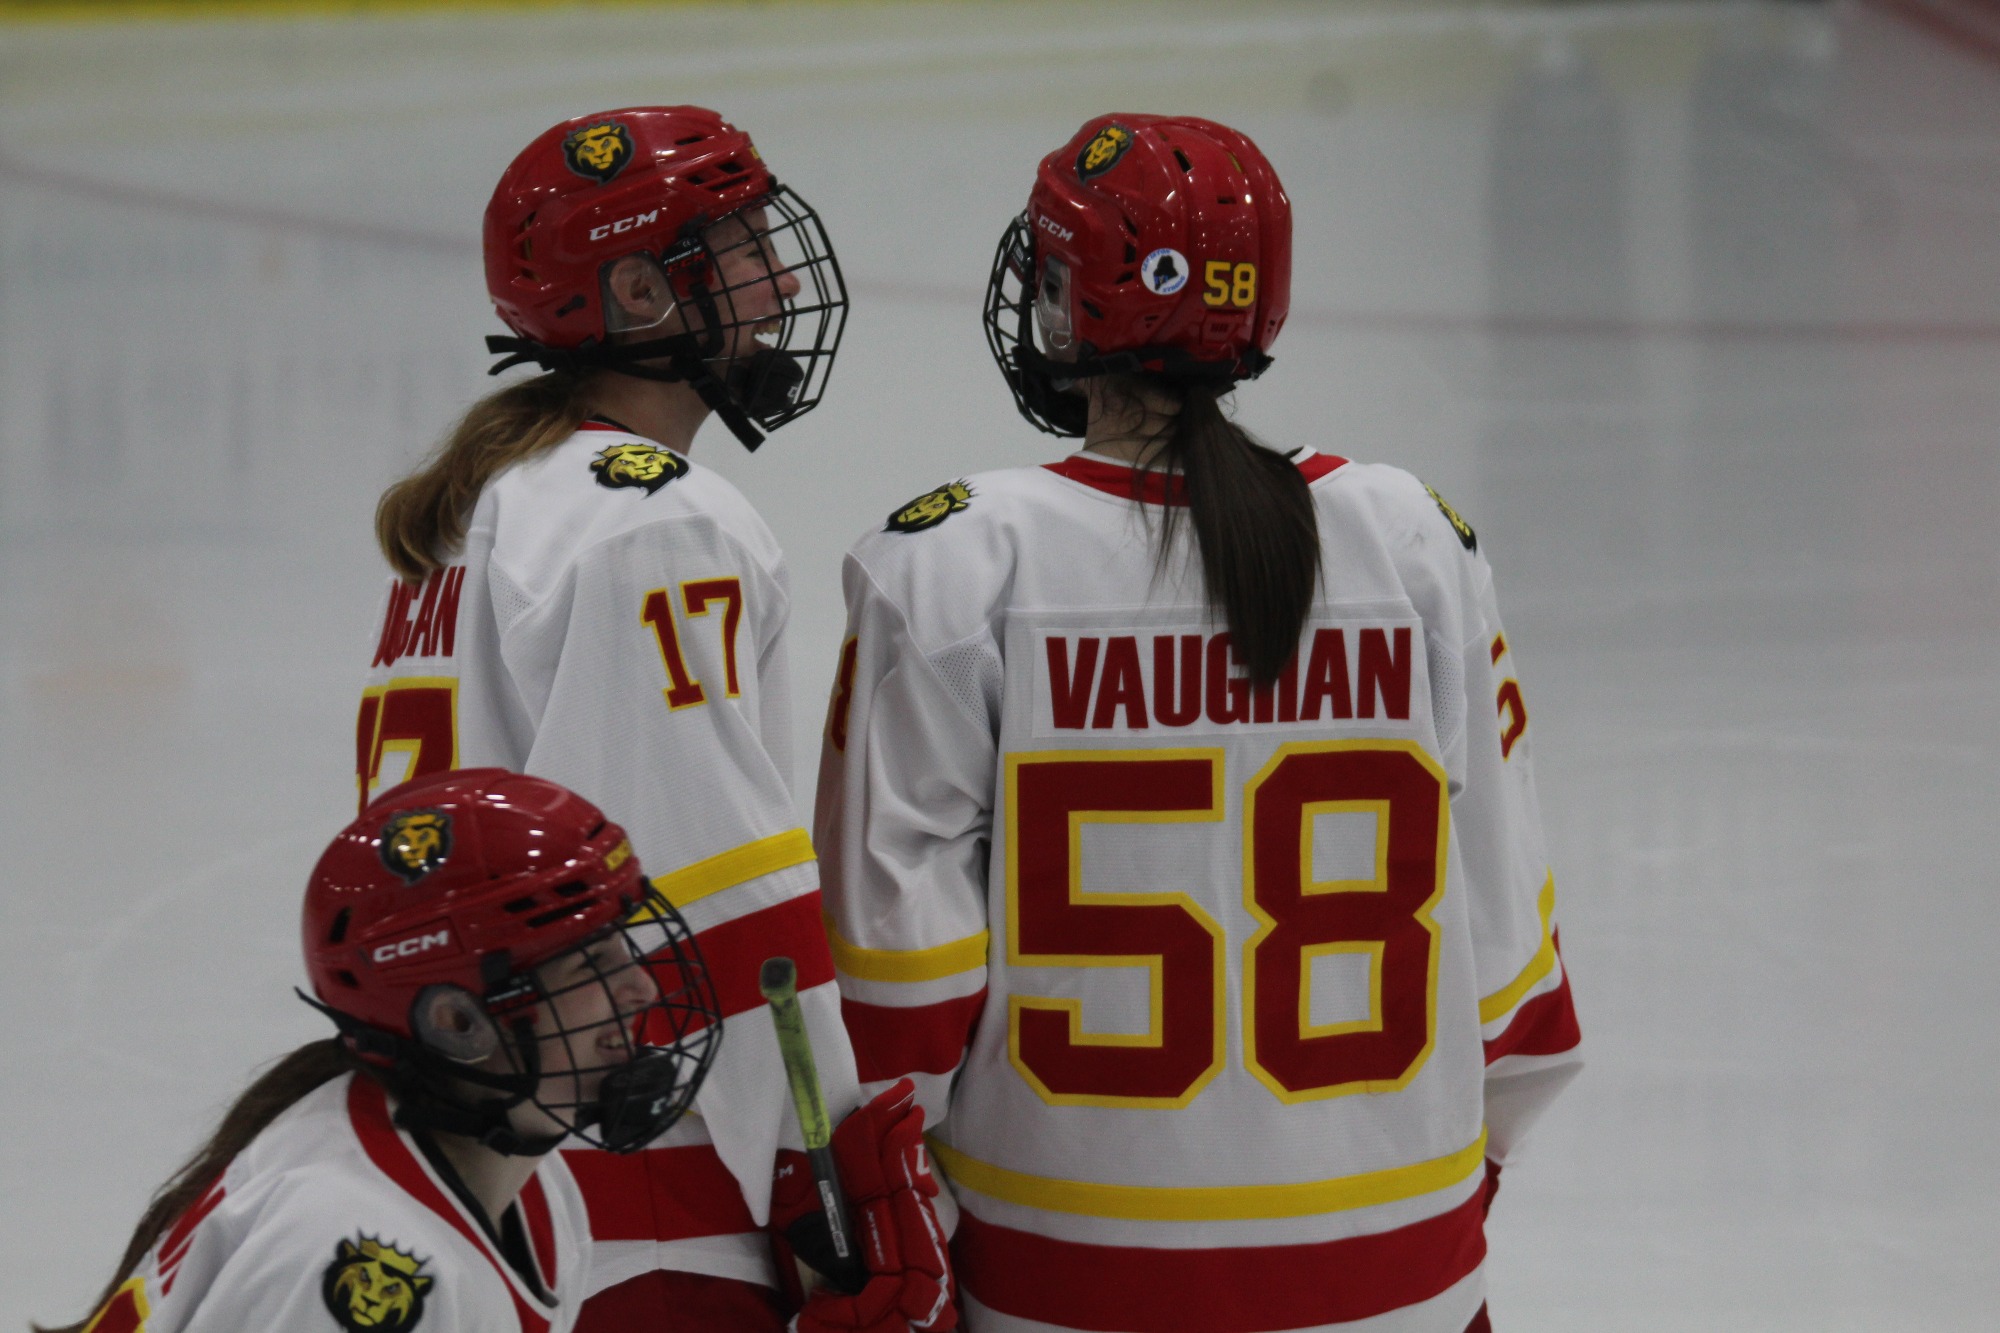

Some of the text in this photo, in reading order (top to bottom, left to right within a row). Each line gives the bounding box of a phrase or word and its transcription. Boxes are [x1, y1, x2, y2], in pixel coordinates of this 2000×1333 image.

[589, 209, 659, 241] CCM
[1038, 214, 1074, 241] CCM
[1203, 260, 1256, 307] 58
[639, 576, 743, 713] 17
[1004, 738, 1450, 1111] 58
[373, 929, 449, 963] CCM
